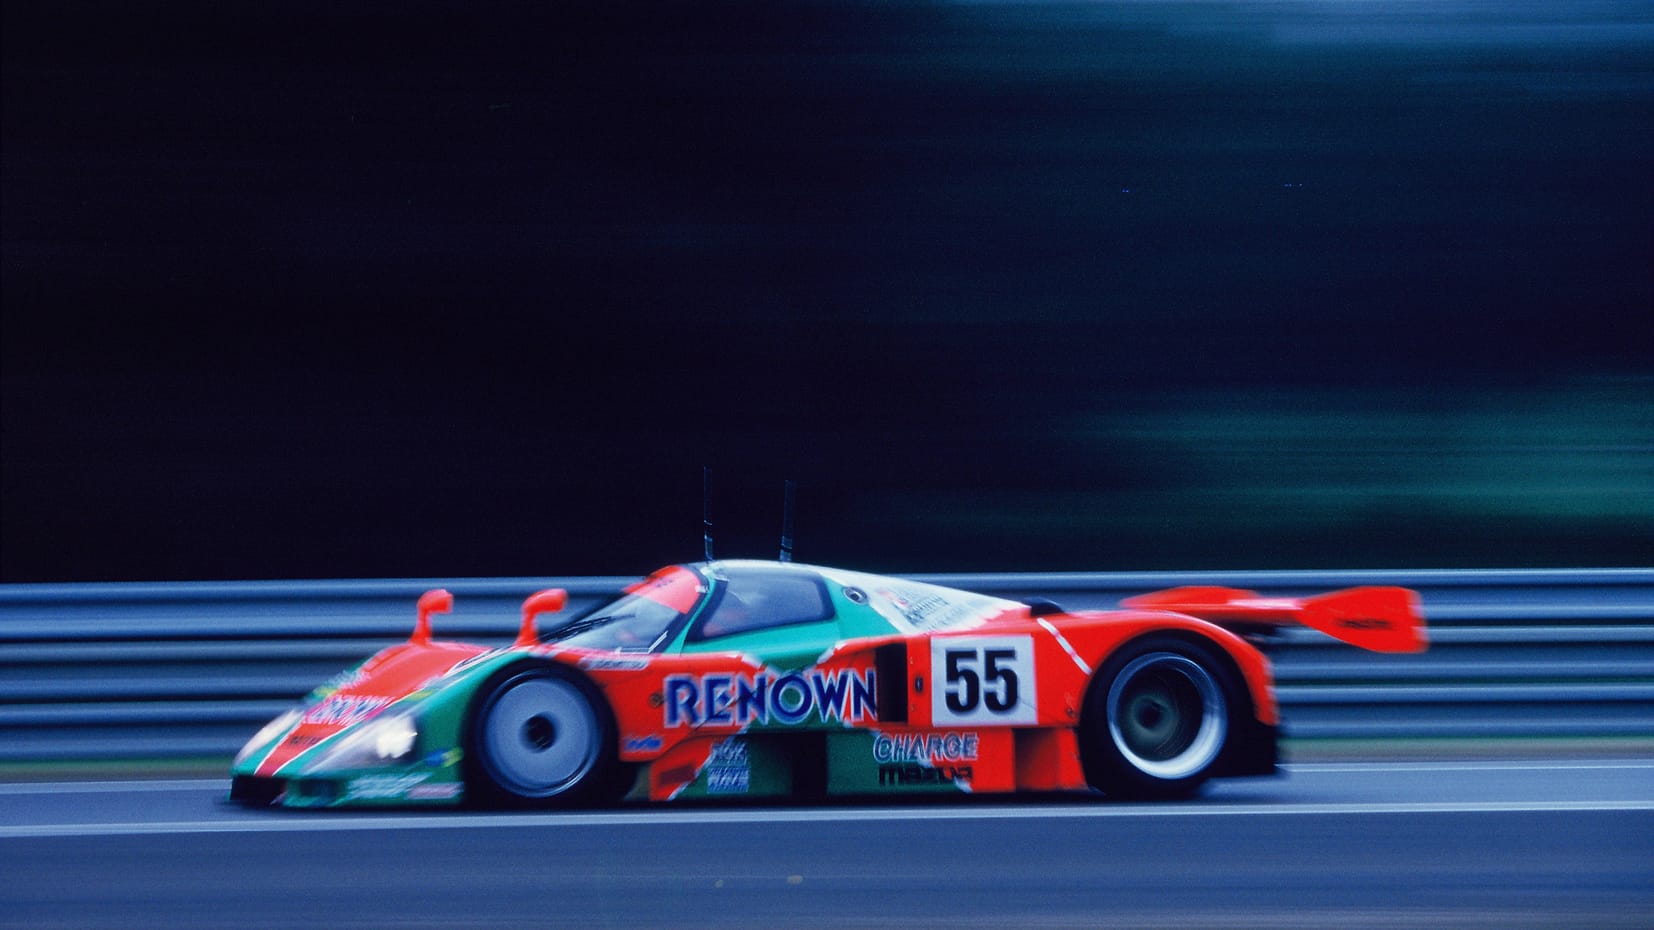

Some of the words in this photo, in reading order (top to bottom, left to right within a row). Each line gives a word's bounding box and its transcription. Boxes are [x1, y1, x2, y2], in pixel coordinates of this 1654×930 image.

[663, 668, 877, 728] RENOWN
[945, 649, 1018, 714] 55
[873, 732, 979, 763] CHARGE
